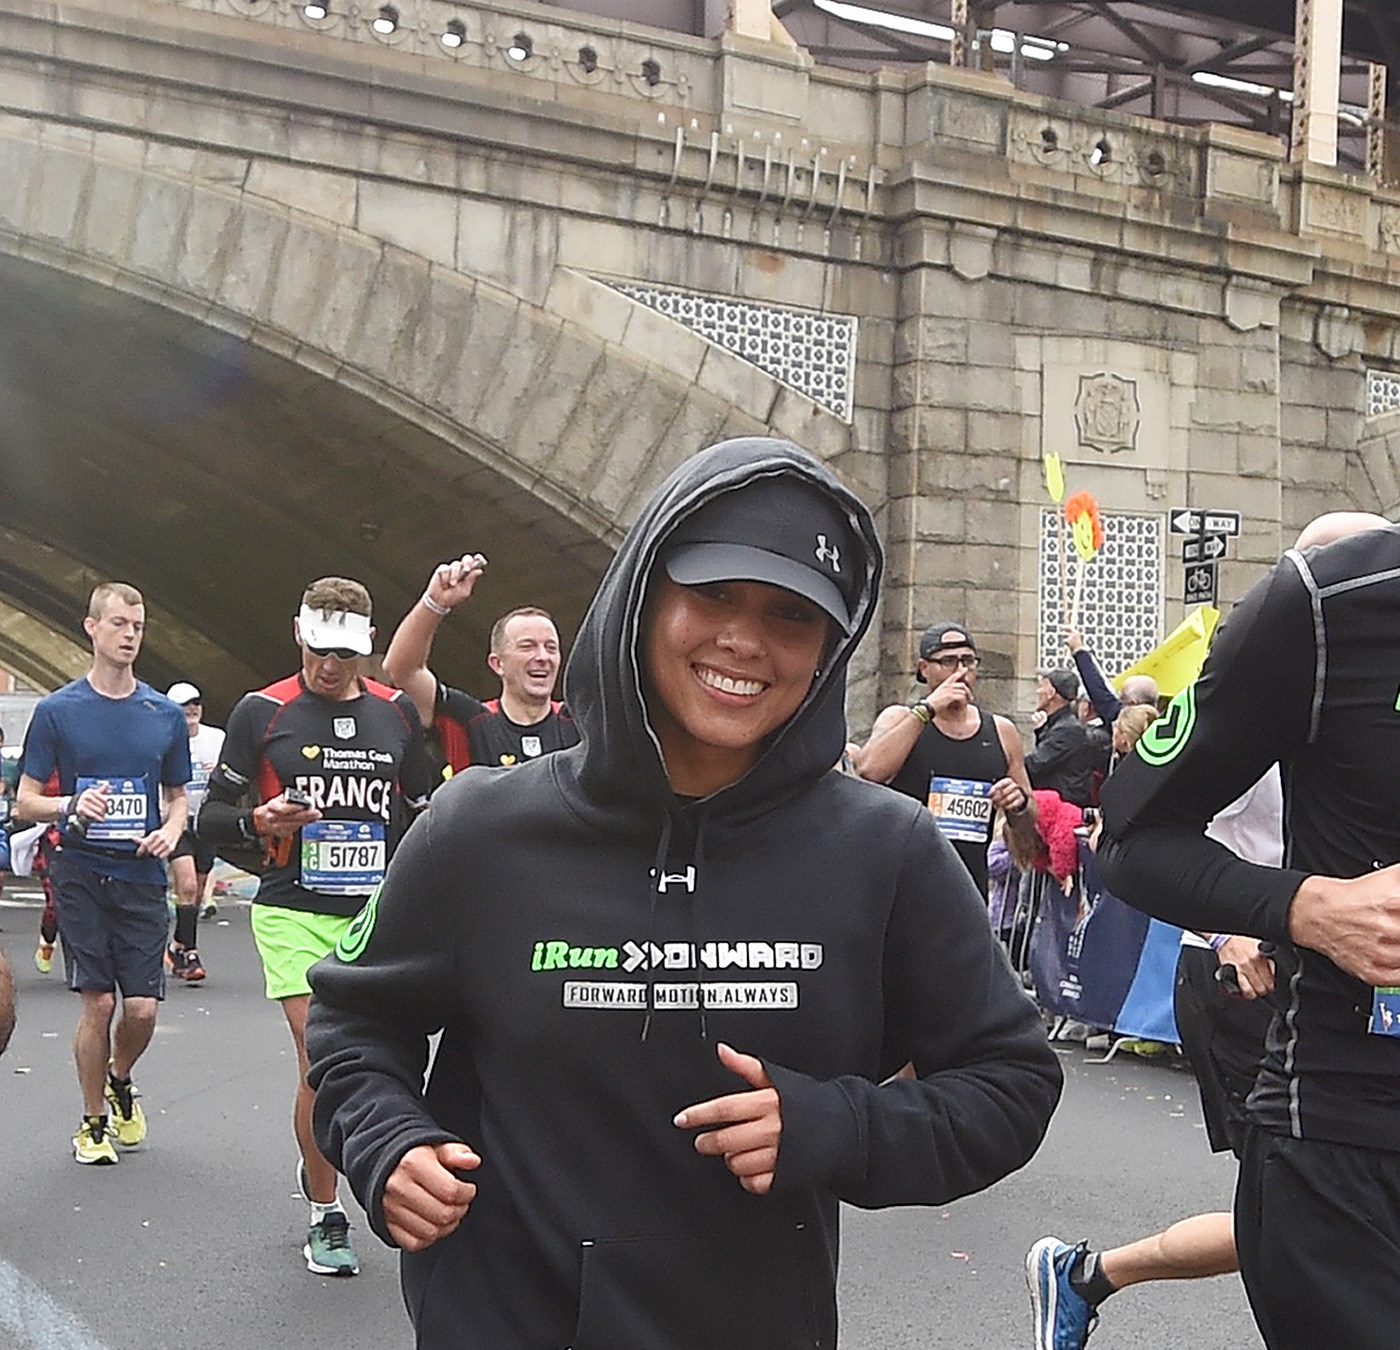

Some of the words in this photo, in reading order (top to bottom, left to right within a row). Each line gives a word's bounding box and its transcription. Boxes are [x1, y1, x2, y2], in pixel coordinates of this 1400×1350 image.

[322, 747, 367, 760] Thomas
[323, 760, 375, 771] Marathon
[295, 776, 392, 821] FRANCE
[947, 798, 989, 819] 45602
[329, 845, 379, 868] 51787
[531, 940, 619, 972] iRun
[663, 941, 824, 970] ONWARD
